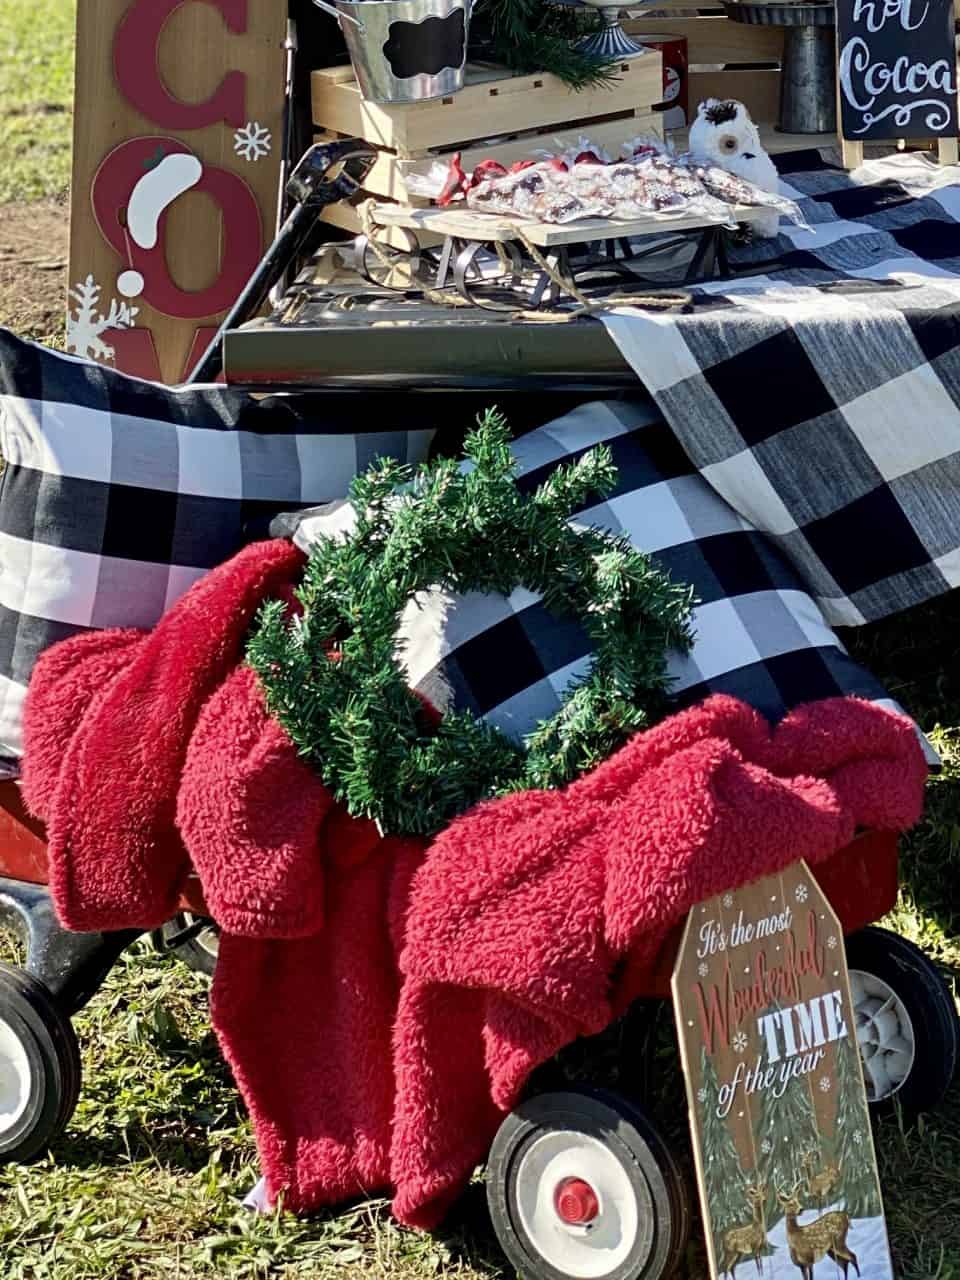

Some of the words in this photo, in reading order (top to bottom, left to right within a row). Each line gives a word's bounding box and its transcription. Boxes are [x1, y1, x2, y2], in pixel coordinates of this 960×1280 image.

[840, 36, 957, 111] Cocoa
[697, 919, 729, 958] It's
[730, 910, 756, 948] the
[755, 906, 794, 938] most
[692, 909, 826, 1056] Wonderful
[757, 989, 849, 1064] TIME
[716, 1062, 746, 1118] of
[744, 1055, 778, 1096] the
[771, 1047, 826, 1098] year
